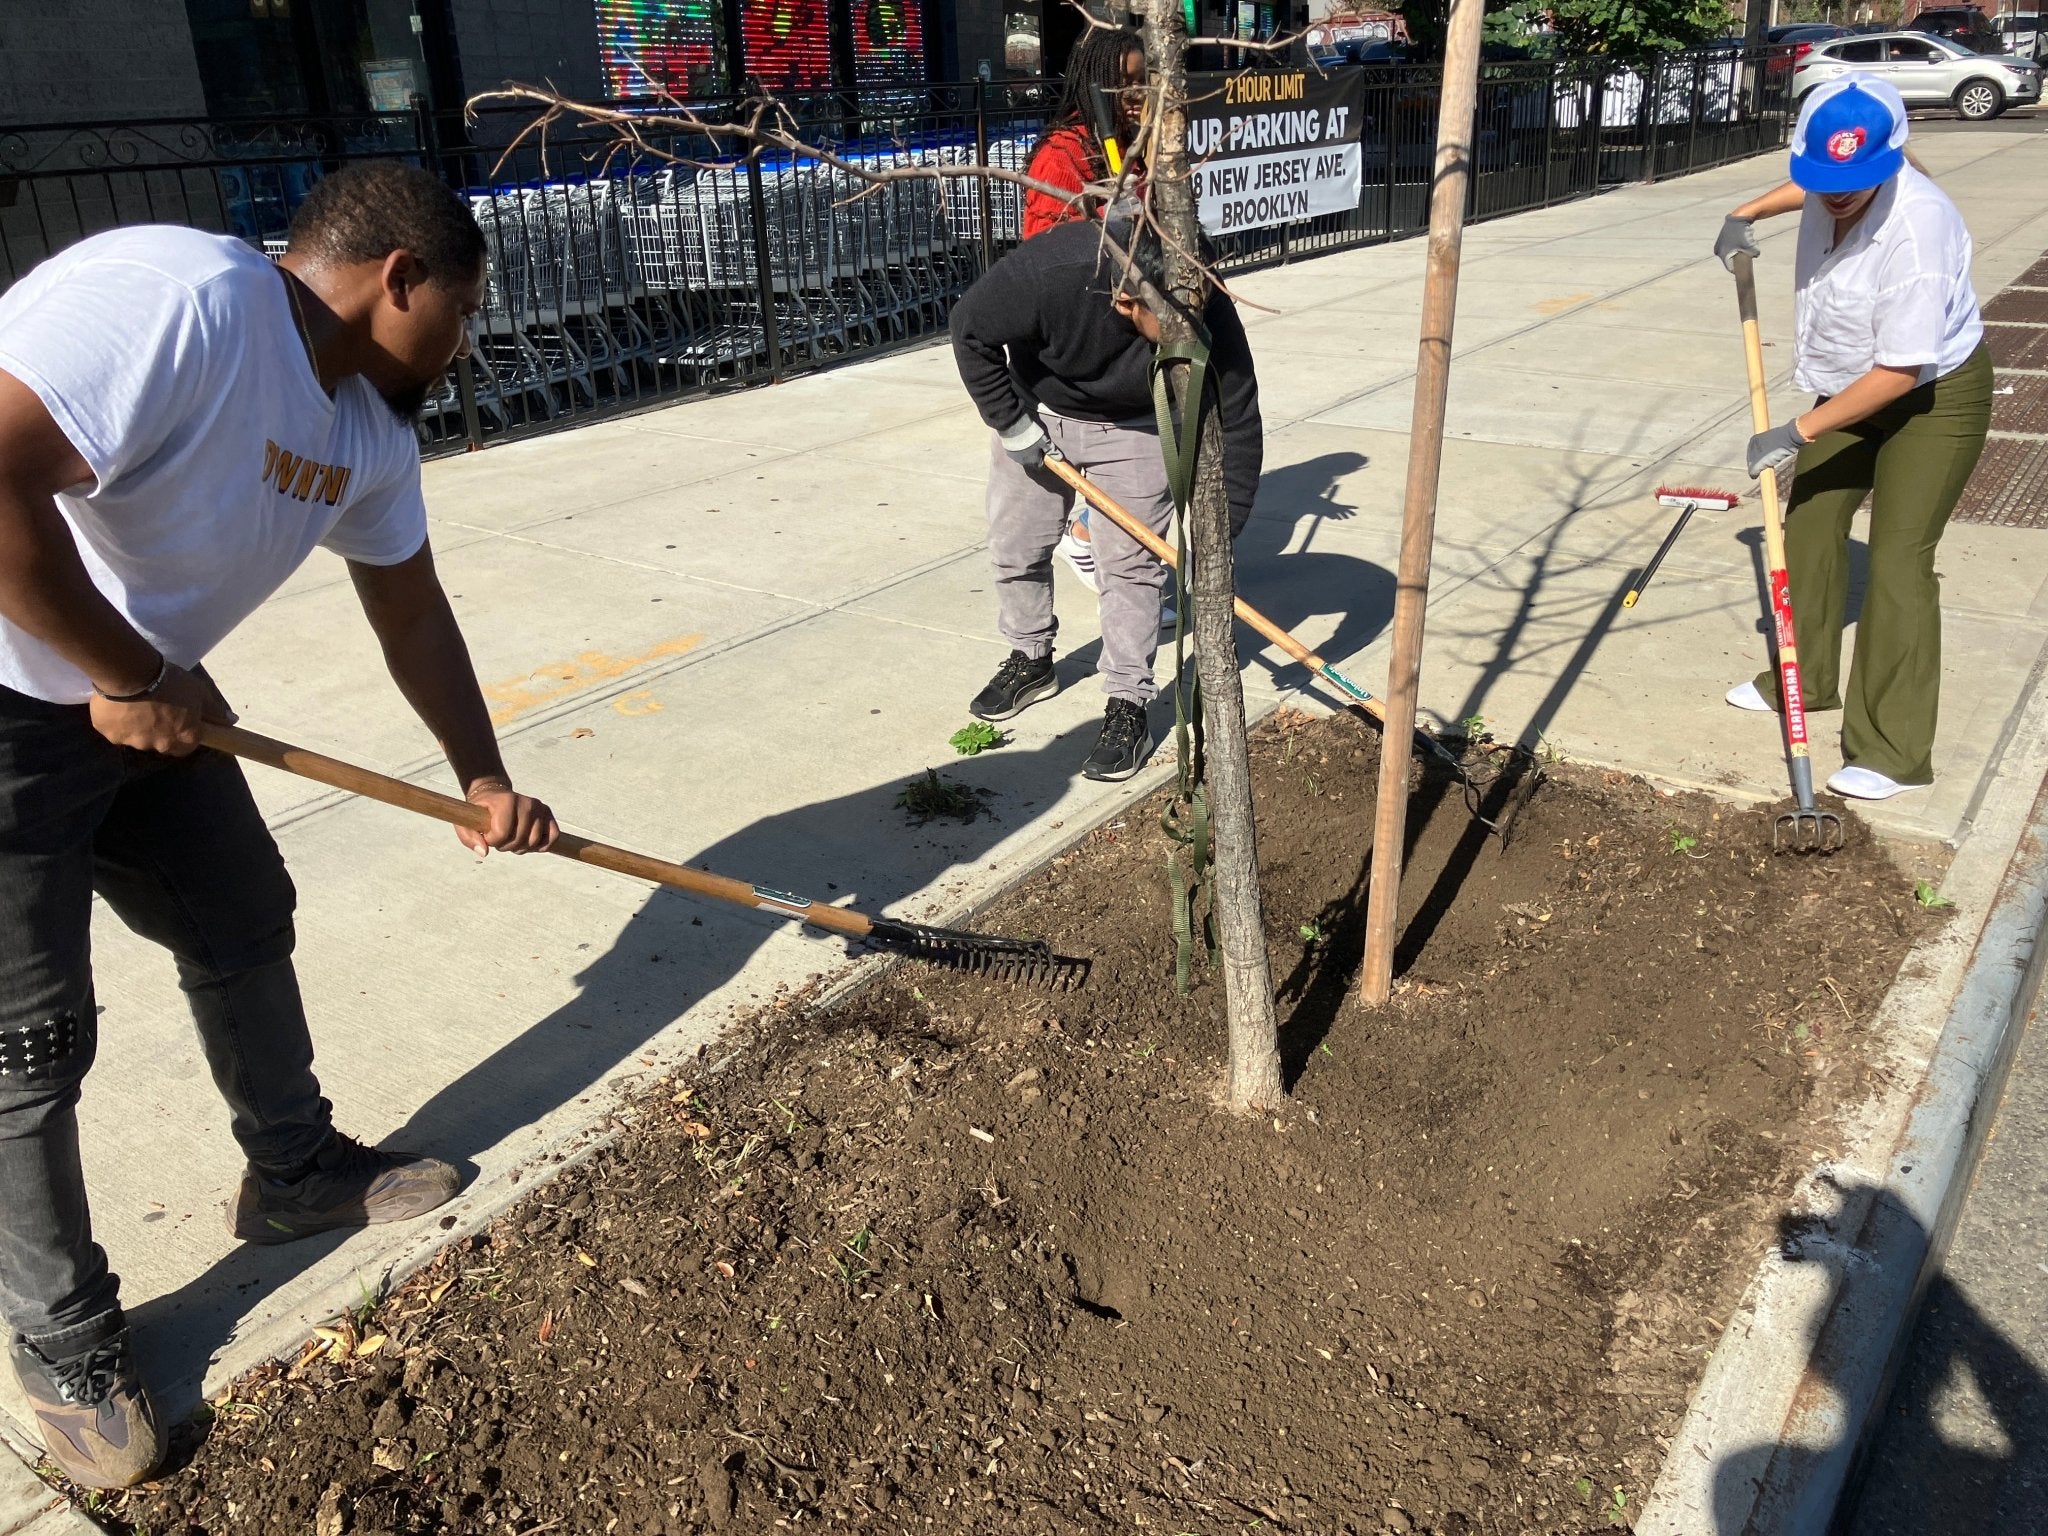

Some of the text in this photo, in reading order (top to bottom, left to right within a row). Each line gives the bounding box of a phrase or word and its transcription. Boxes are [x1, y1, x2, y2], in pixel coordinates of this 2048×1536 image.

[1225, 74, 1305, 104] 2 HOUR LIMIT
[1230, 109, 1320, 151] PARKING
[1325, 107, 1349, 139] AT
[1209, 166, 1249, 197] NEW
[1254, 157, 1311, 190] JERSEY
[1315, 153, 1346, 181] AVE.
[1221, 190, 1309, 228] BROOKLYN
[1785, 667, 1804, 739] CRAFTSMAN
